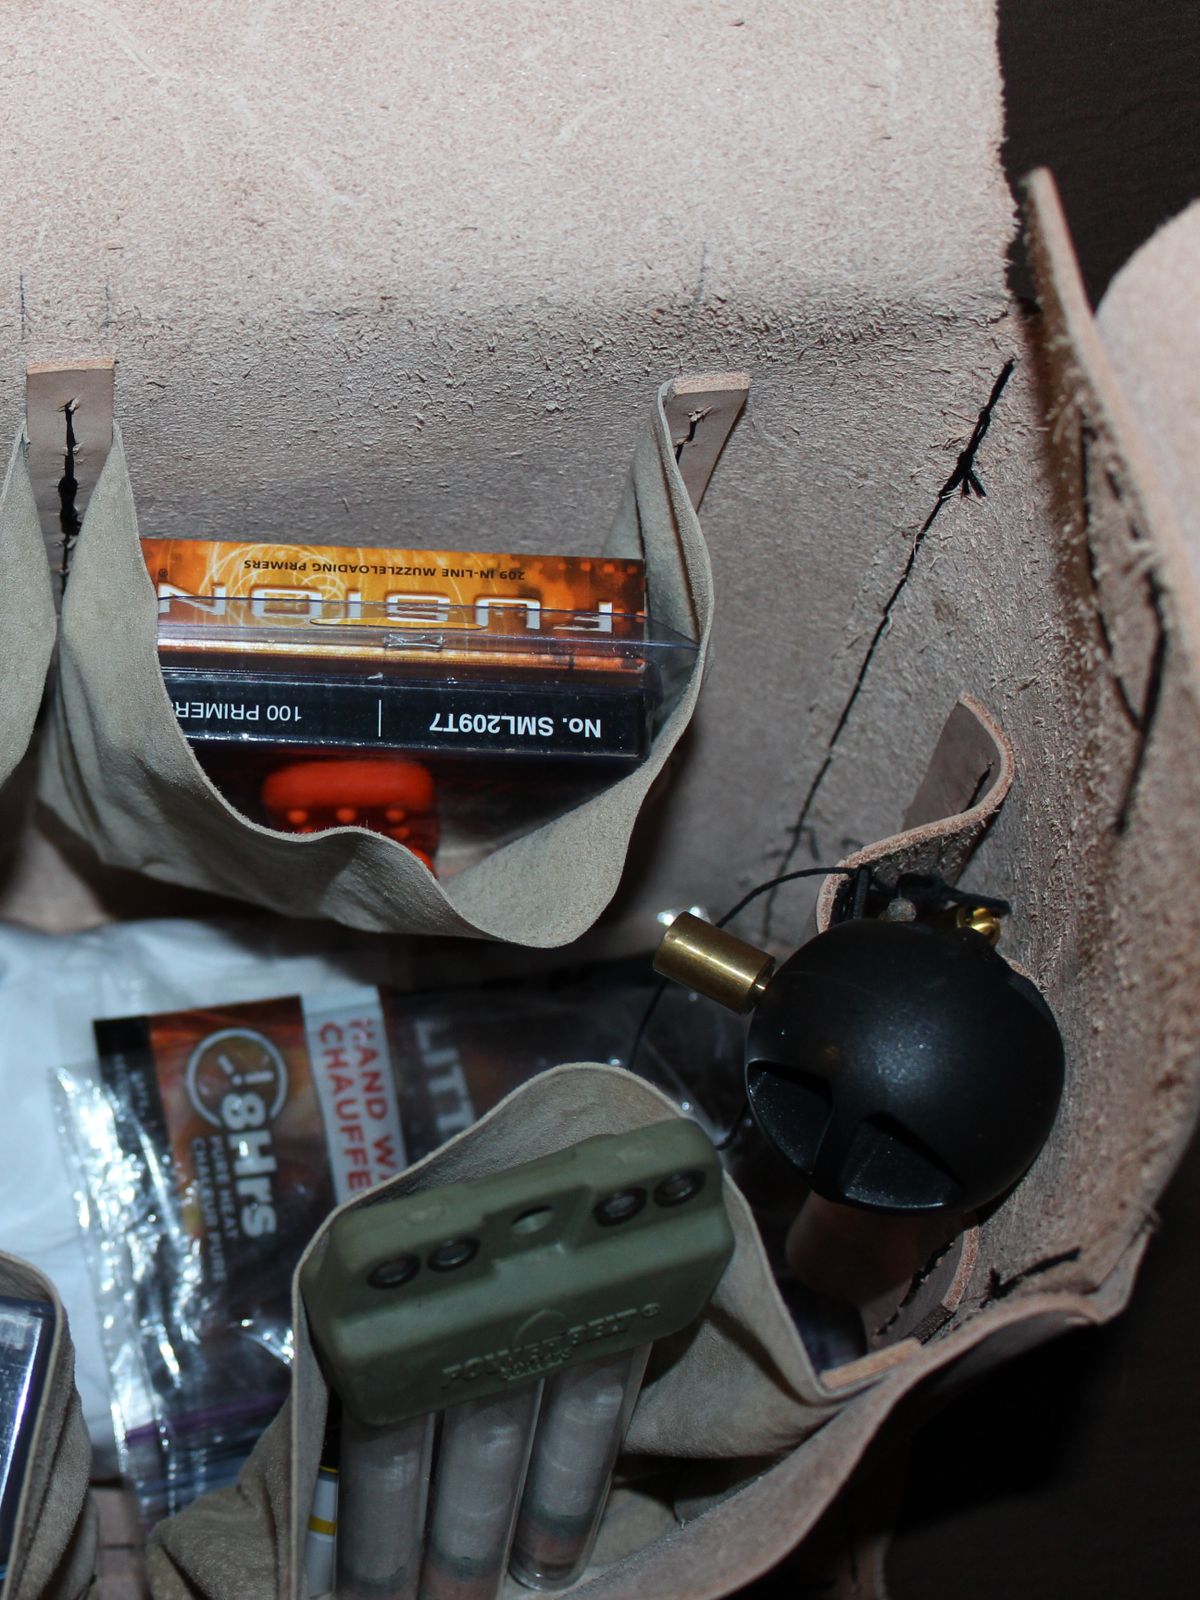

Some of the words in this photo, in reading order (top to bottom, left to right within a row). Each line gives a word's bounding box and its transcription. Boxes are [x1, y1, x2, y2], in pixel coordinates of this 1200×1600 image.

[243, 559, 307, 571] PRIMERS
[311, 562, 436, 578] MUZZLELOADING
[441, 568, 495, 580] IN-LINE
[499, 570, 525, 581] 209
[158, 582, 612, 633] FUSION
[172, 702, 260, 721] PRIMER
[266, 705, 302, 722] 100
[429, 712, 554, 736] SML209T7
[562, 717, 601, 738] No.
